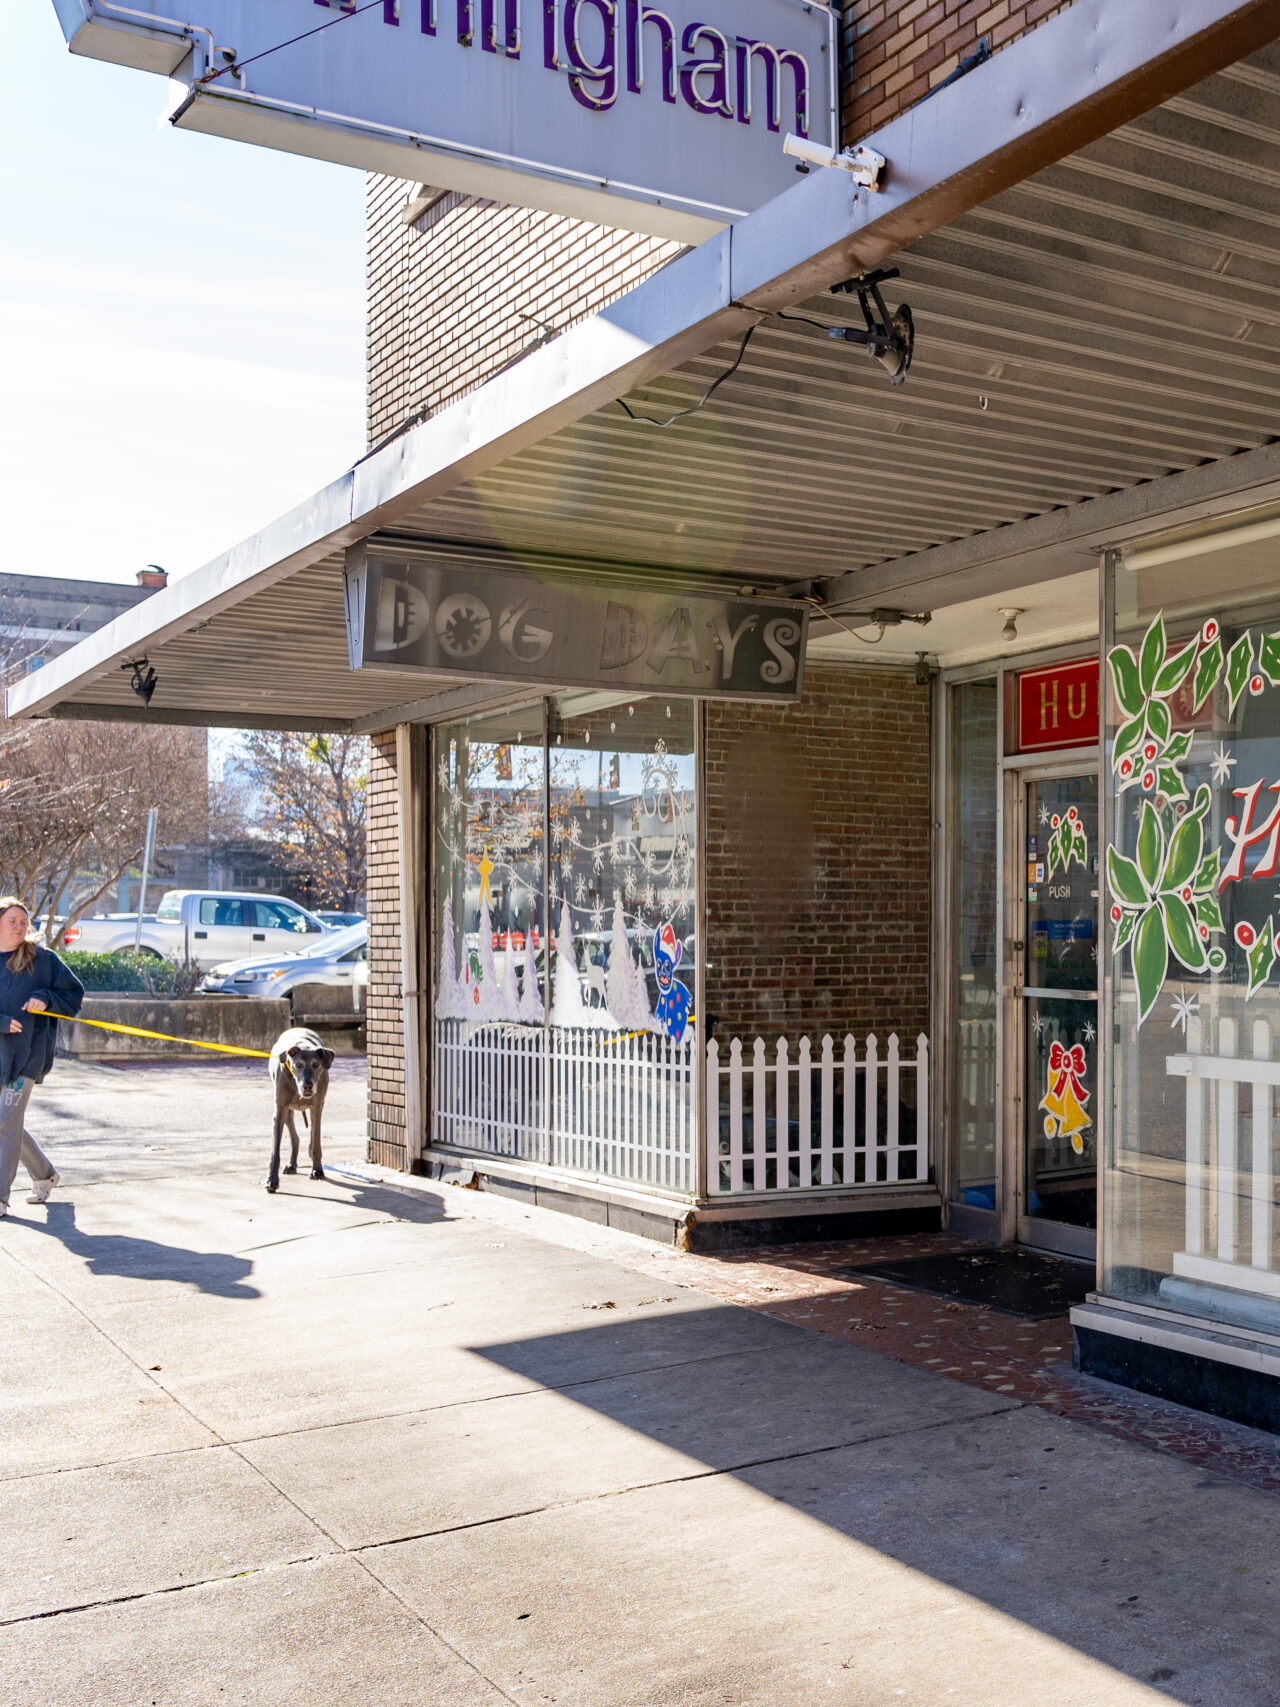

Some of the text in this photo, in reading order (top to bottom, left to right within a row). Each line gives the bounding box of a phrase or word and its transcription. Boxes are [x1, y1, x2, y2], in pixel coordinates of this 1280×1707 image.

[373, 576, 801, 684] DOG DAYS
[1057, 780, 1081, 805] 112
[1048, 884, 1071, 899] PUSH
[5, 1091, 23, 1106] 87
